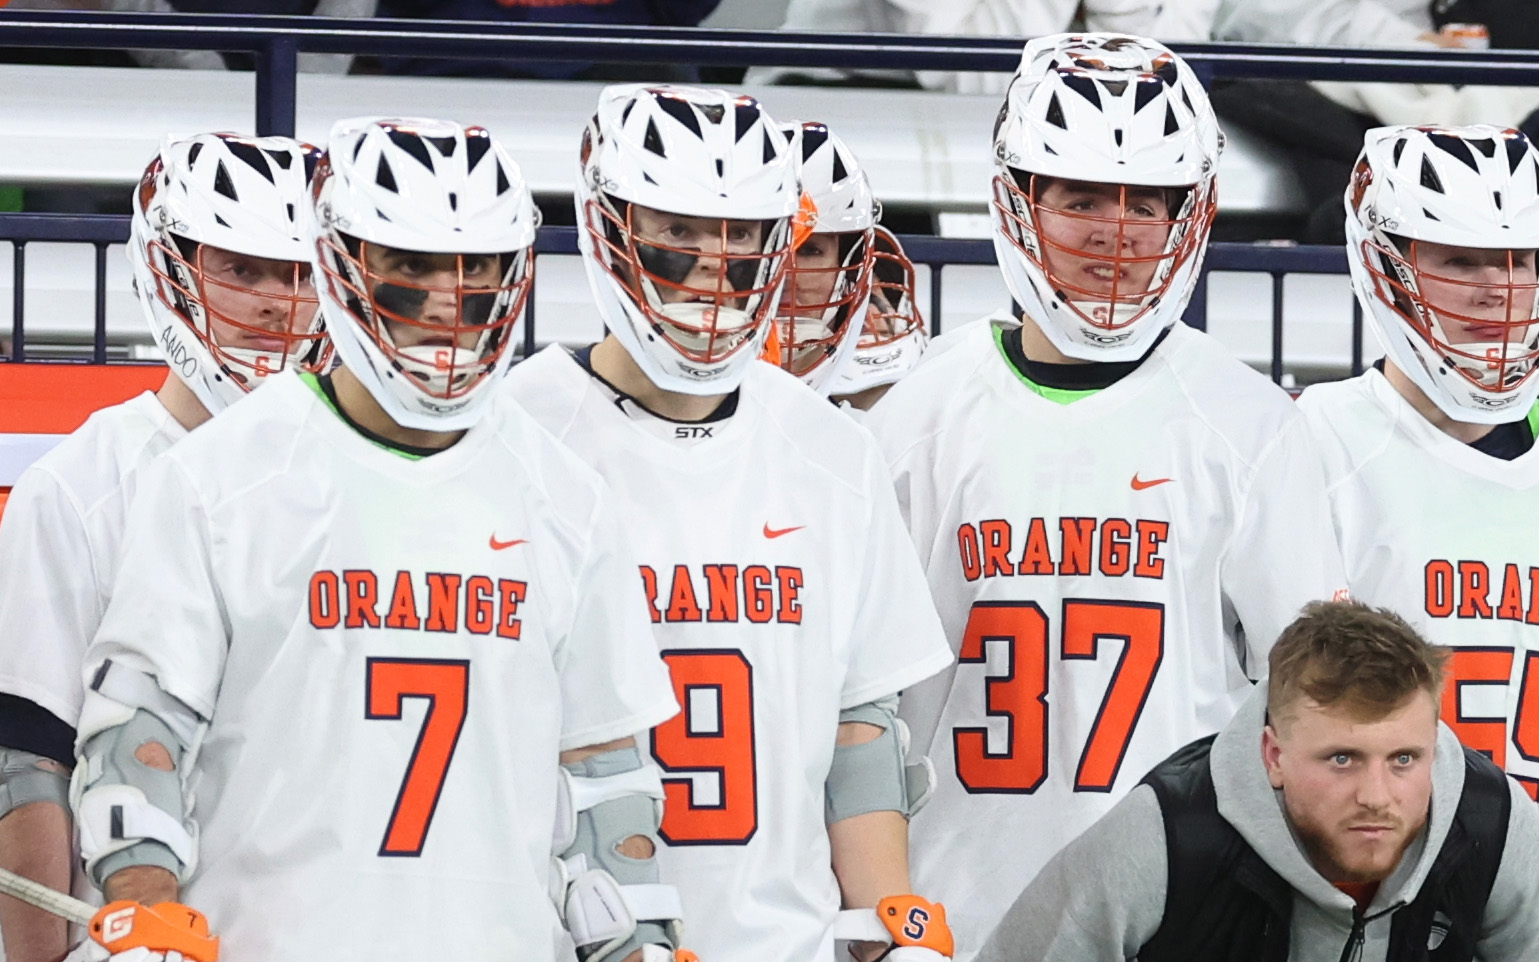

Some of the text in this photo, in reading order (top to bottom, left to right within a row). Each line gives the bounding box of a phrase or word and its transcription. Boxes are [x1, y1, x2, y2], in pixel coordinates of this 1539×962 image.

[675, 427, 713, 438] STX
[958, 517, 1170, 582] ORANGE
[309, 570, 527, 640] ORANGE
[952, 597, 1166, 795] 37
[365, 656, 471, 858] 7
[650, 648, 758, 847] 9
[901, 905, 930, 941] S
